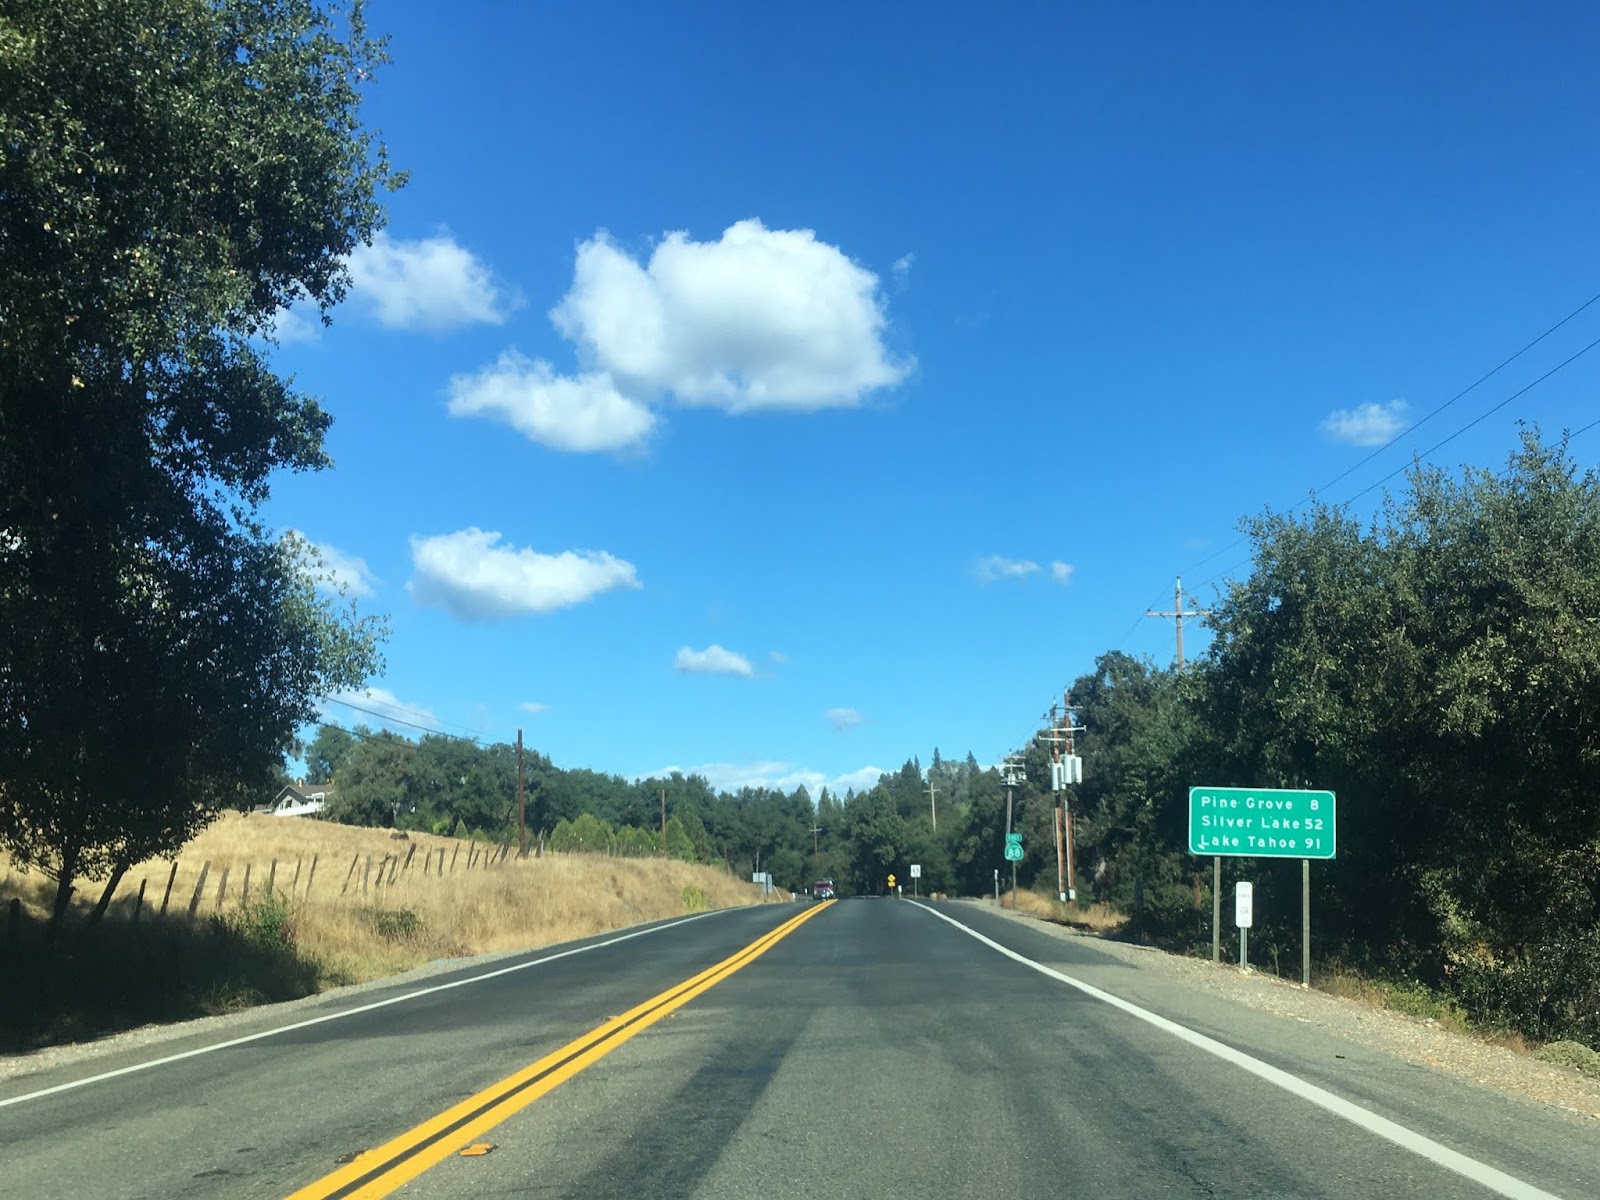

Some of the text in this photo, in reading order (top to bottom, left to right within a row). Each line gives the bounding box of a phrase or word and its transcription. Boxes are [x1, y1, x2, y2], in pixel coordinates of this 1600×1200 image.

[1201, 796, 1319, 811] Pine Grove 8
[1201, 815, 1323, 830] Silver Lake 52
[1200, 834, 1320, 849] Lake Tahoe 91
[1008, 848, 1020, 857] 88
